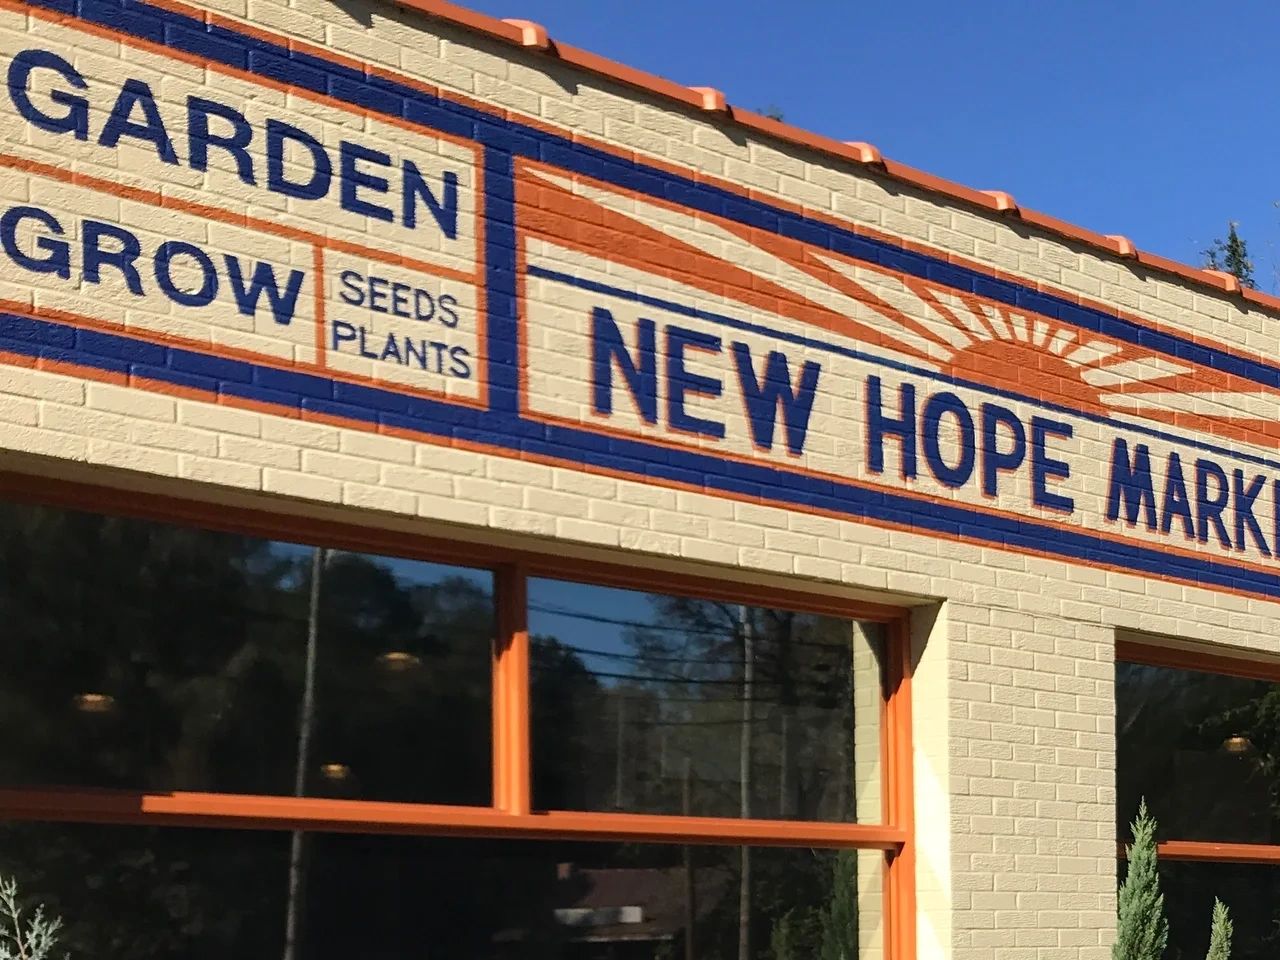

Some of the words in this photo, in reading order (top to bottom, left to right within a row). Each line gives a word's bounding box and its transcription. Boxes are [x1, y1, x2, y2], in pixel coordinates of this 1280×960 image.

[7, 49, 459, 240] GARDEN
[0, 206, 305, 325] GROW
[339, 270, 459, 328] SEEDS
[332, 320, 472, 379] PLANTS
[590, 306, 821, 456] NEW
[865, 374, 1075, 514] HOPE
